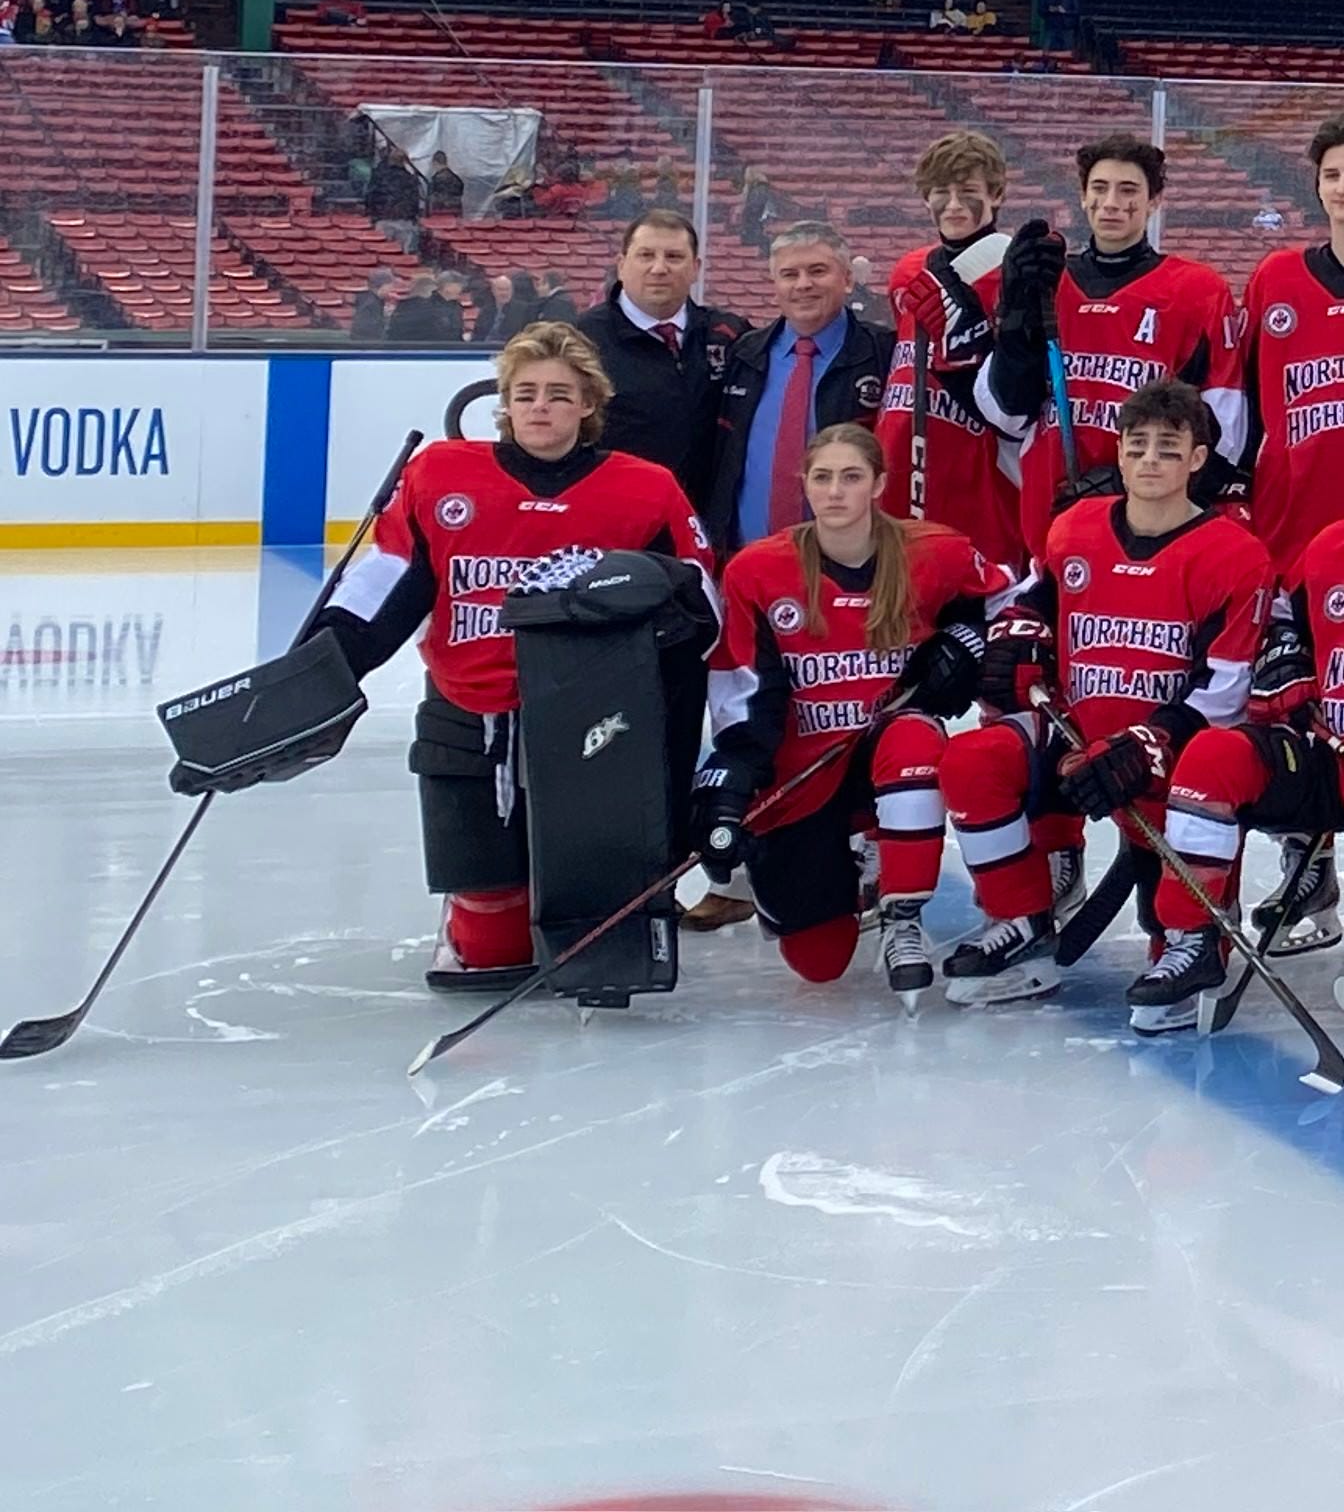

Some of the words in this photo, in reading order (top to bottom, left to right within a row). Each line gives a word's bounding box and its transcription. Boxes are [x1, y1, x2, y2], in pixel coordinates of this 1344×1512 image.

[1133, 308, 1158, 345] A
[1060, 351, 1168, 392] RTHERN
[10, 407, 170, 478] VODKA
[780, 643, 915, 691] NORTHE
[1069, 662, 1190, 705] HIGHLAND
[165, 676, 252, 722] BAUER
[796, 695, 882, 736] HIGHL
